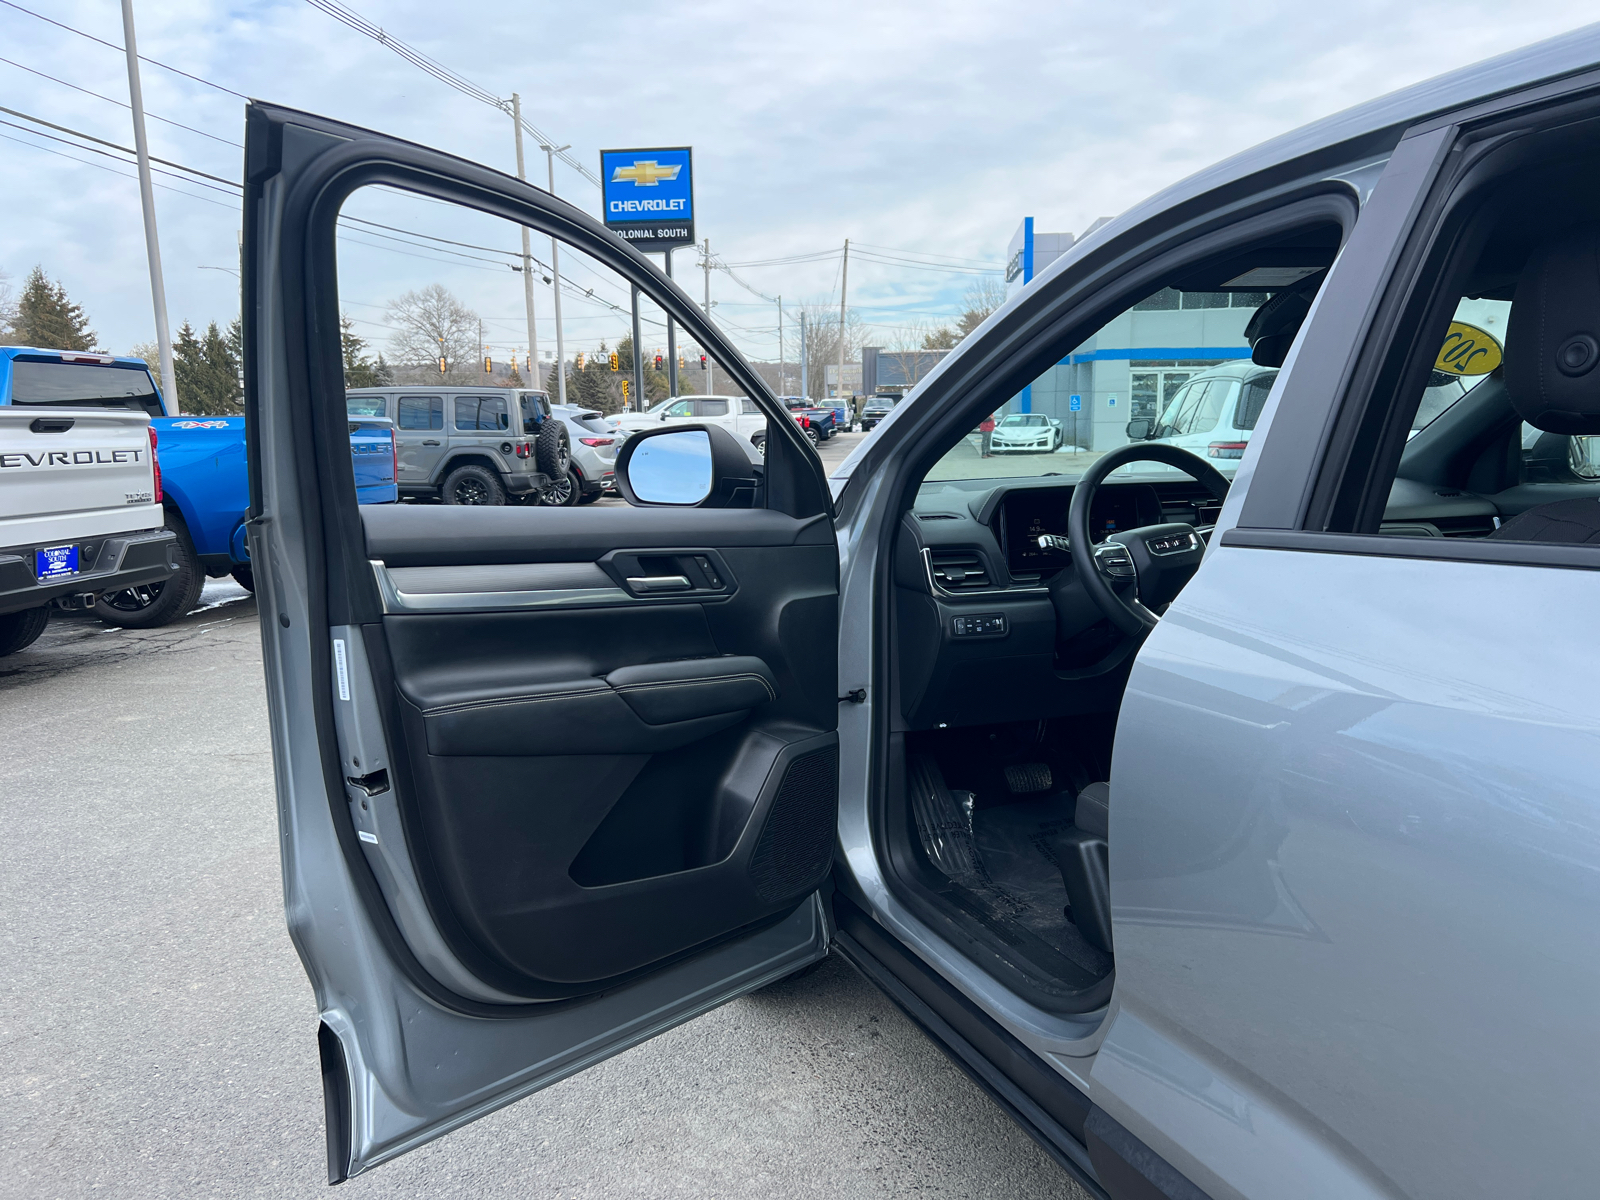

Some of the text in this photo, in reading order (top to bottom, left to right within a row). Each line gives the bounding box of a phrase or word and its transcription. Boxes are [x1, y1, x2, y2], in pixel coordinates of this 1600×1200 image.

[610, 199, 686, 212] CHEVROLET
[613, 229, 687, 239] OLONIAL SOUTH
[0, 450, 142, 467] EVROLET
